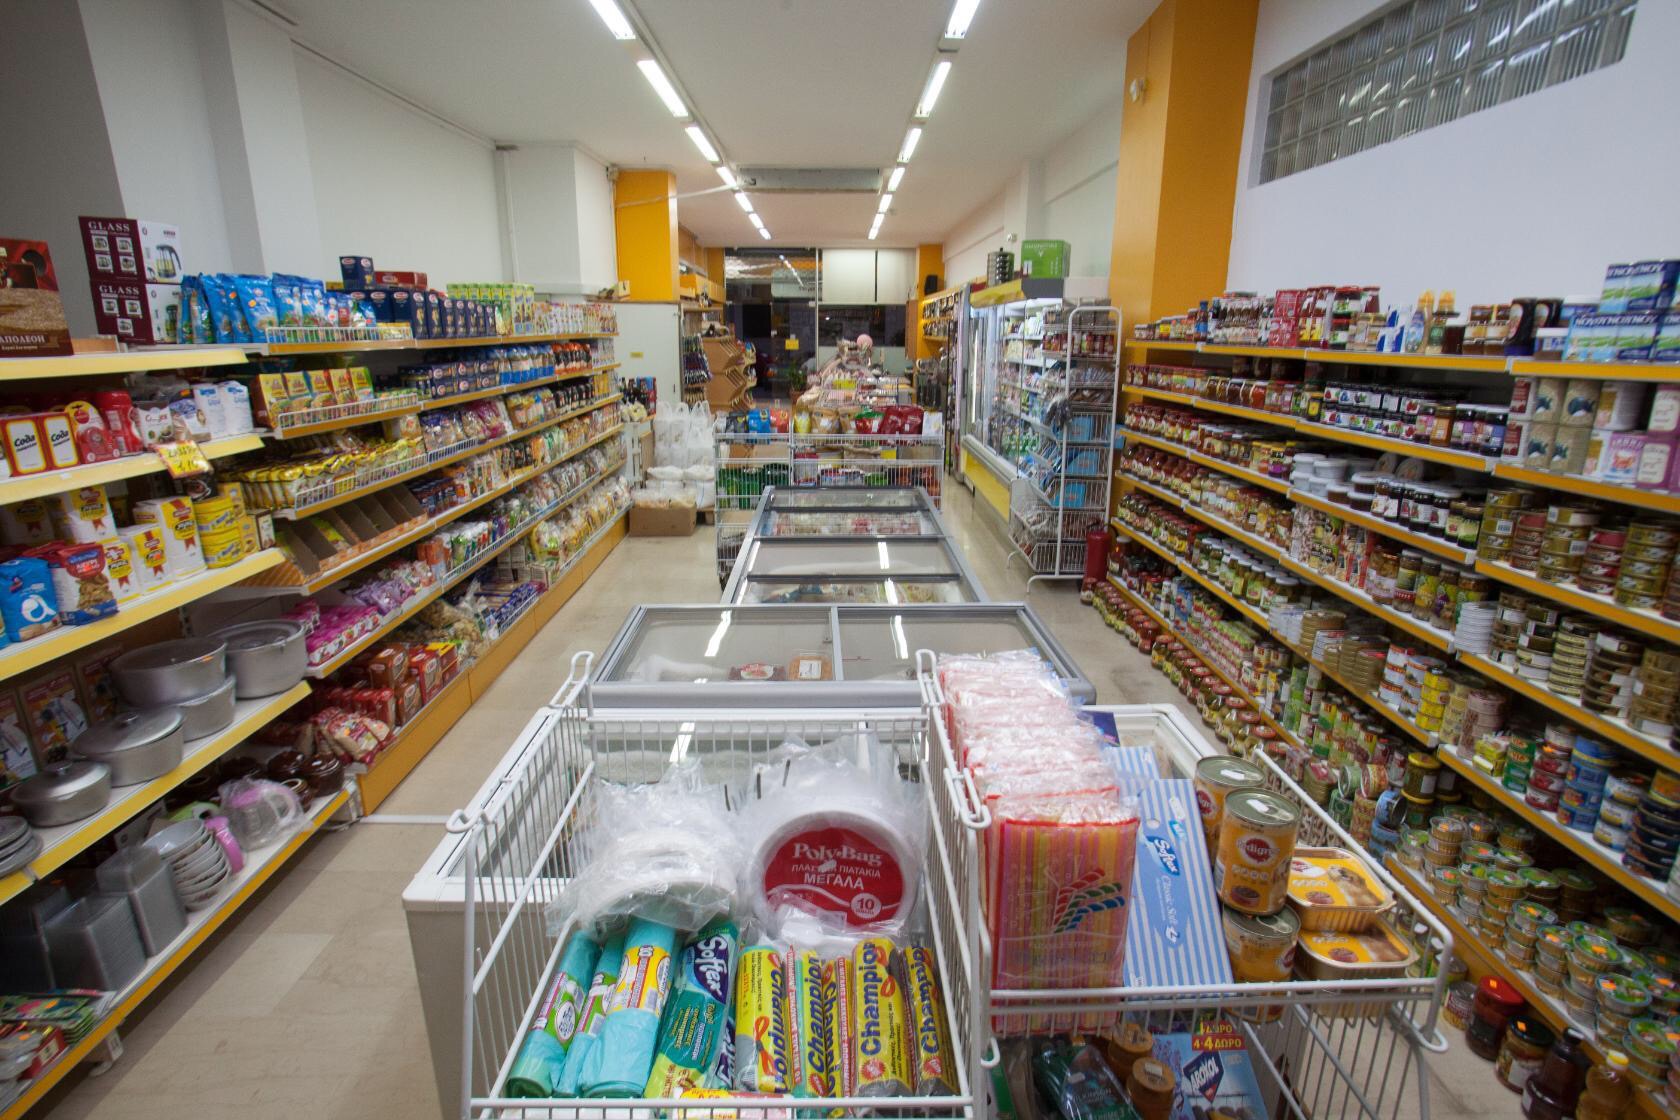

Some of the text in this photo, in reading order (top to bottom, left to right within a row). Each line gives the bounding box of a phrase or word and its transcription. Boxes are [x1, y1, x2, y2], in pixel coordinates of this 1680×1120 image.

[88, 221, 130, 232] GLASS
[99, 285, 139, 295] GLASS
[1155, 838, 1178, 873] Softex
[839, 865, 881, 879] ΠΙΑΤΑΚΙΑ
[804, 872, 864, 891] ΜΕΓΑΛΑ
[856, 897, 875, 910] 10
[693, 935, 729, 995] Softex
[1215, 1038, 1241, 1048] ΔΩΡΟ
